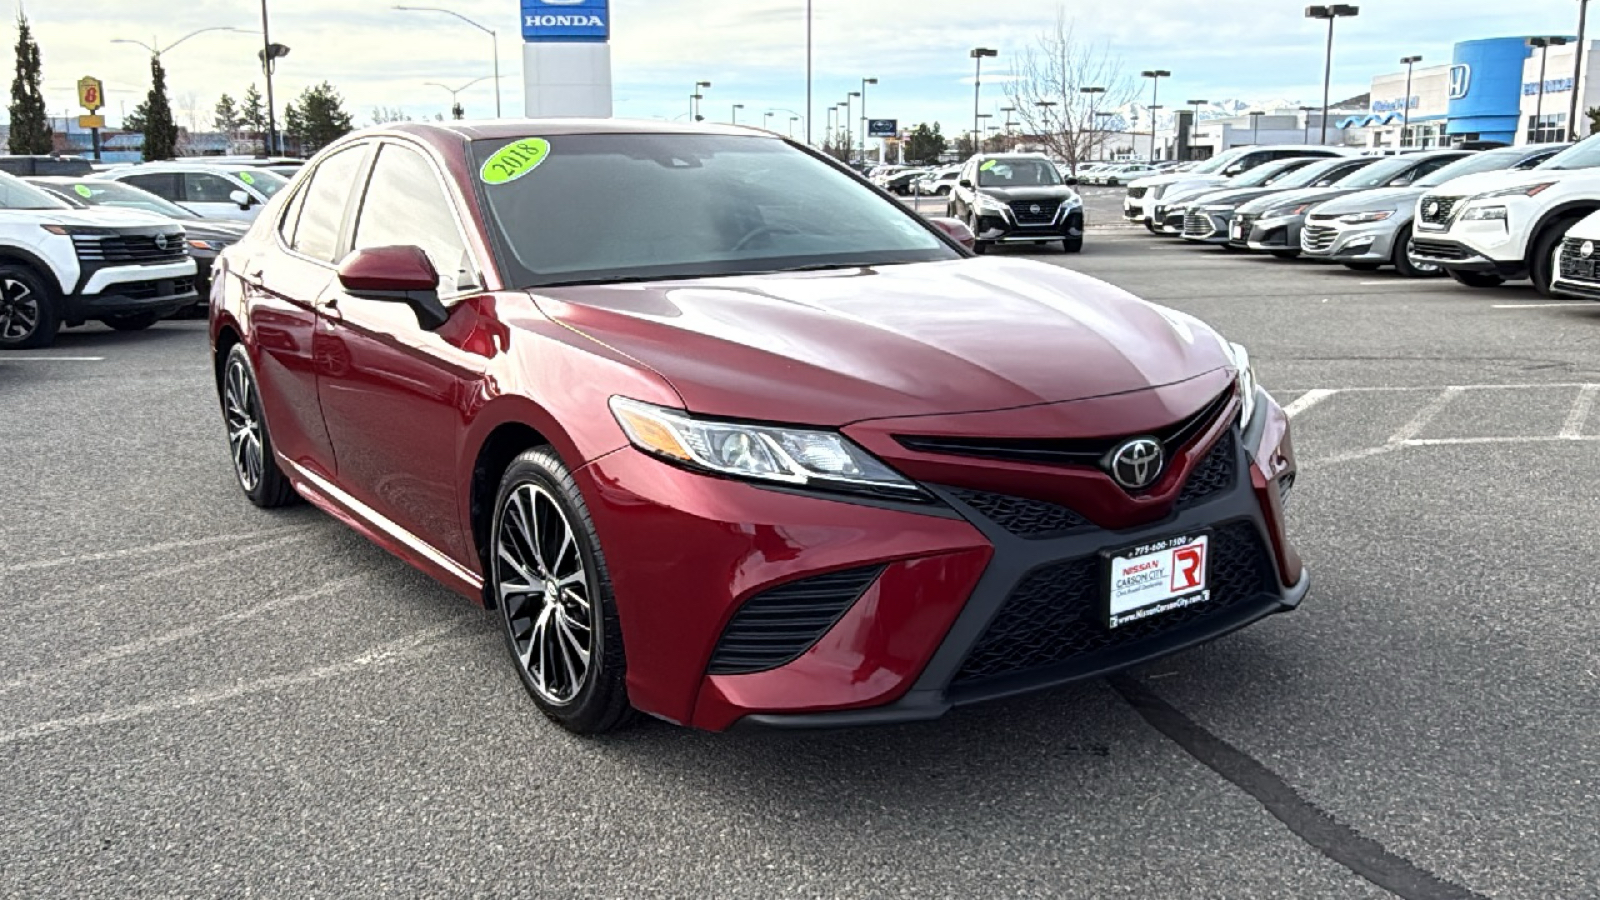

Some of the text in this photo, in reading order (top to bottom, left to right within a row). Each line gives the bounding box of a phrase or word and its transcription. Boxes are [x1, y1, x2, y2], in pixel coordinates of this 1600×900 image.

[525, 15, 604, 26] HONDA
[85, 87, 97, 103] 8
[492, 144, 539, 176] 2018
[1134, 536, 1187, 555] 775-600-1500
[1122, 560, 1159, 576] NISSAN
[1116, 568, 1164, 588] CARSON CITY
